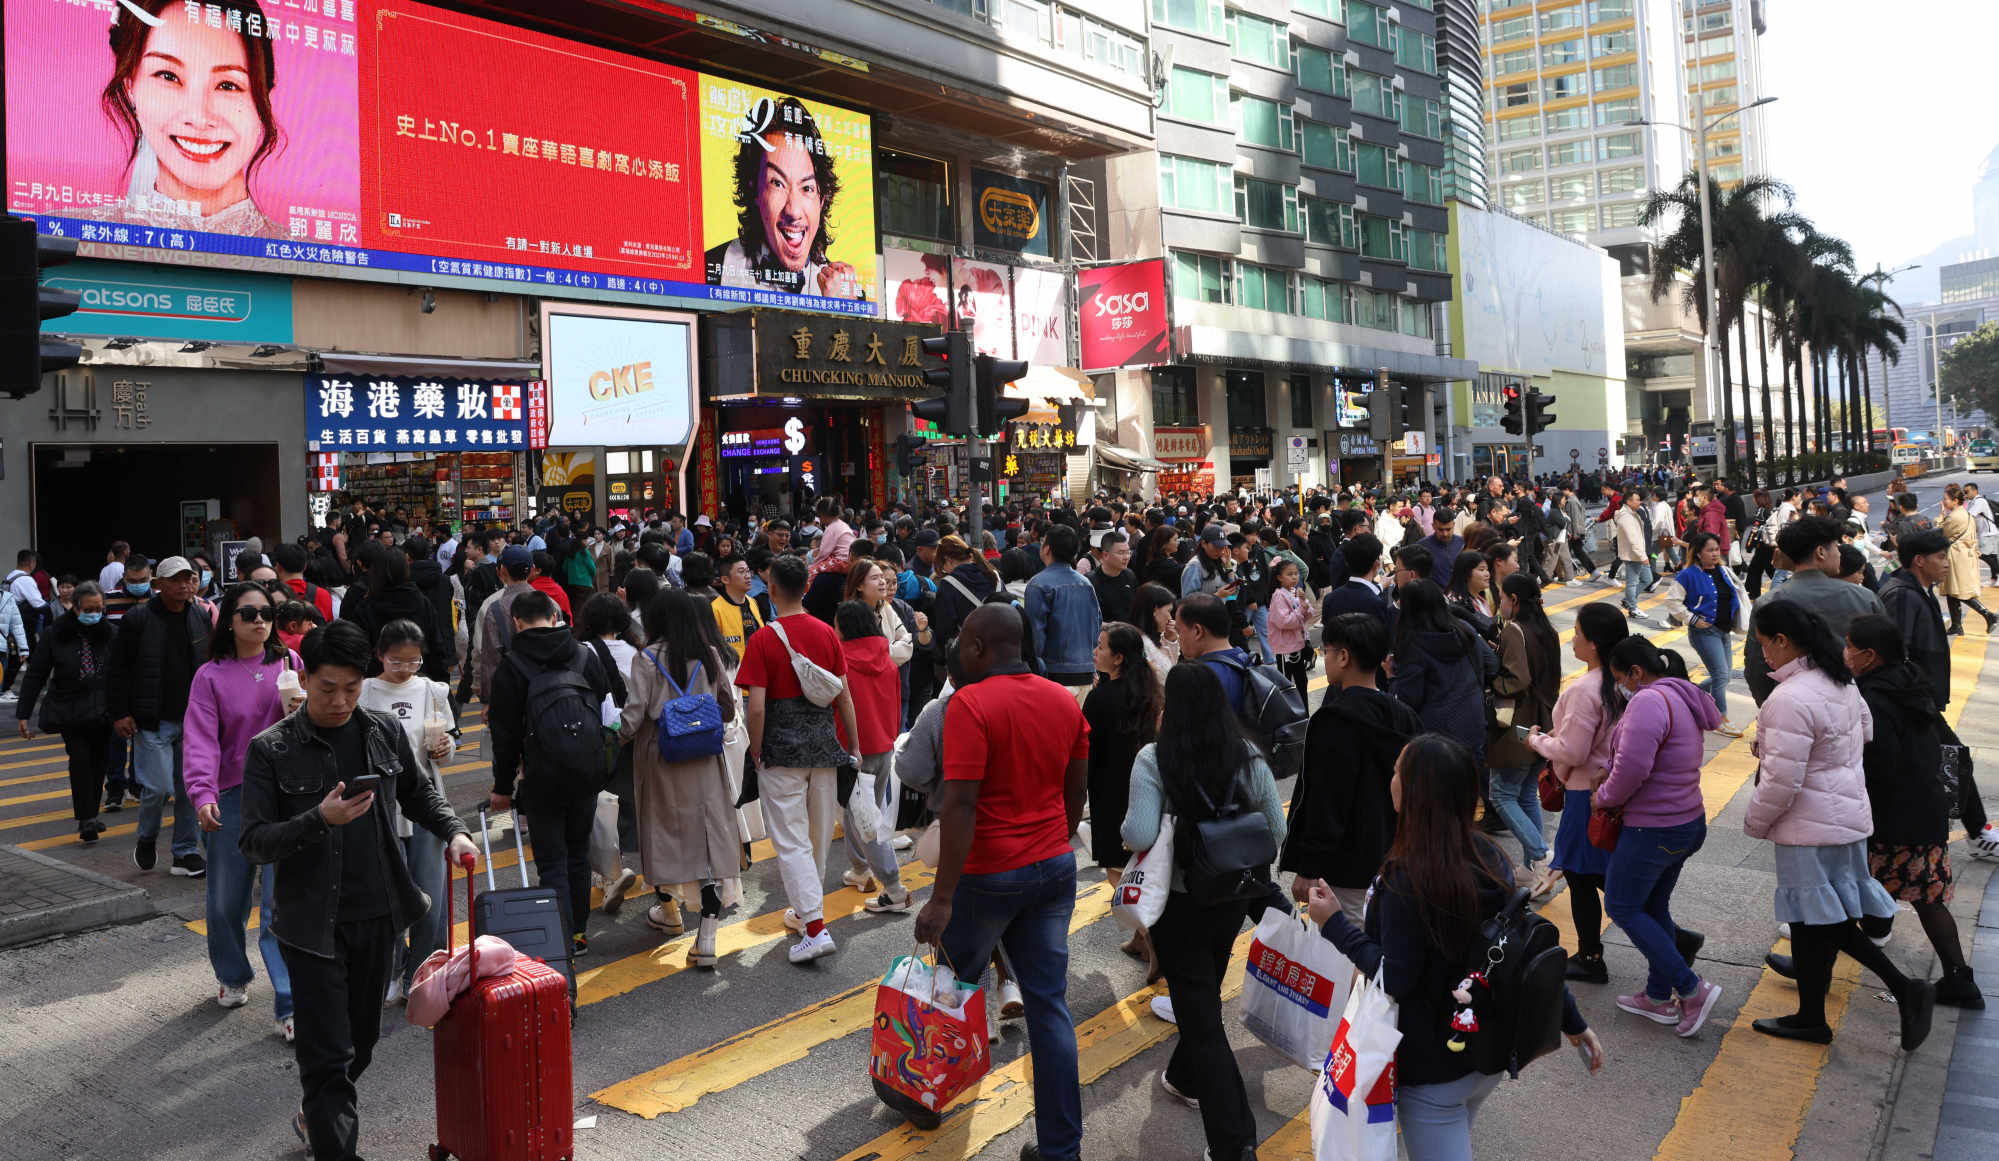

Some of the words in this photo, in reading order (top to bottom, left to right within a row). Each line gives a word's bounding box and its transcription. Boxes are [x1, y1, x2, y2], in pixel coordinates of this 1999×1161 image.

[289, 217, 357, 243] 鄧麗欣
[505, 237, 593, 258] 有請一對新人進場
[80, 288, 172, 310] atsons
[187, 295, 235, 314] 屈臣氏
[588, 361, 655, 401] CKE
[780, 367, 864, 386] CHUNGKING
[867, 374, 928, 388] MANSION
[319, 379, 488, 420] 海港藥妝
[320, 430, 387, 445] 生活百貨
[466, 429, 523, 444] 零售批發
[722, 448, 752, 457] CHANGE
